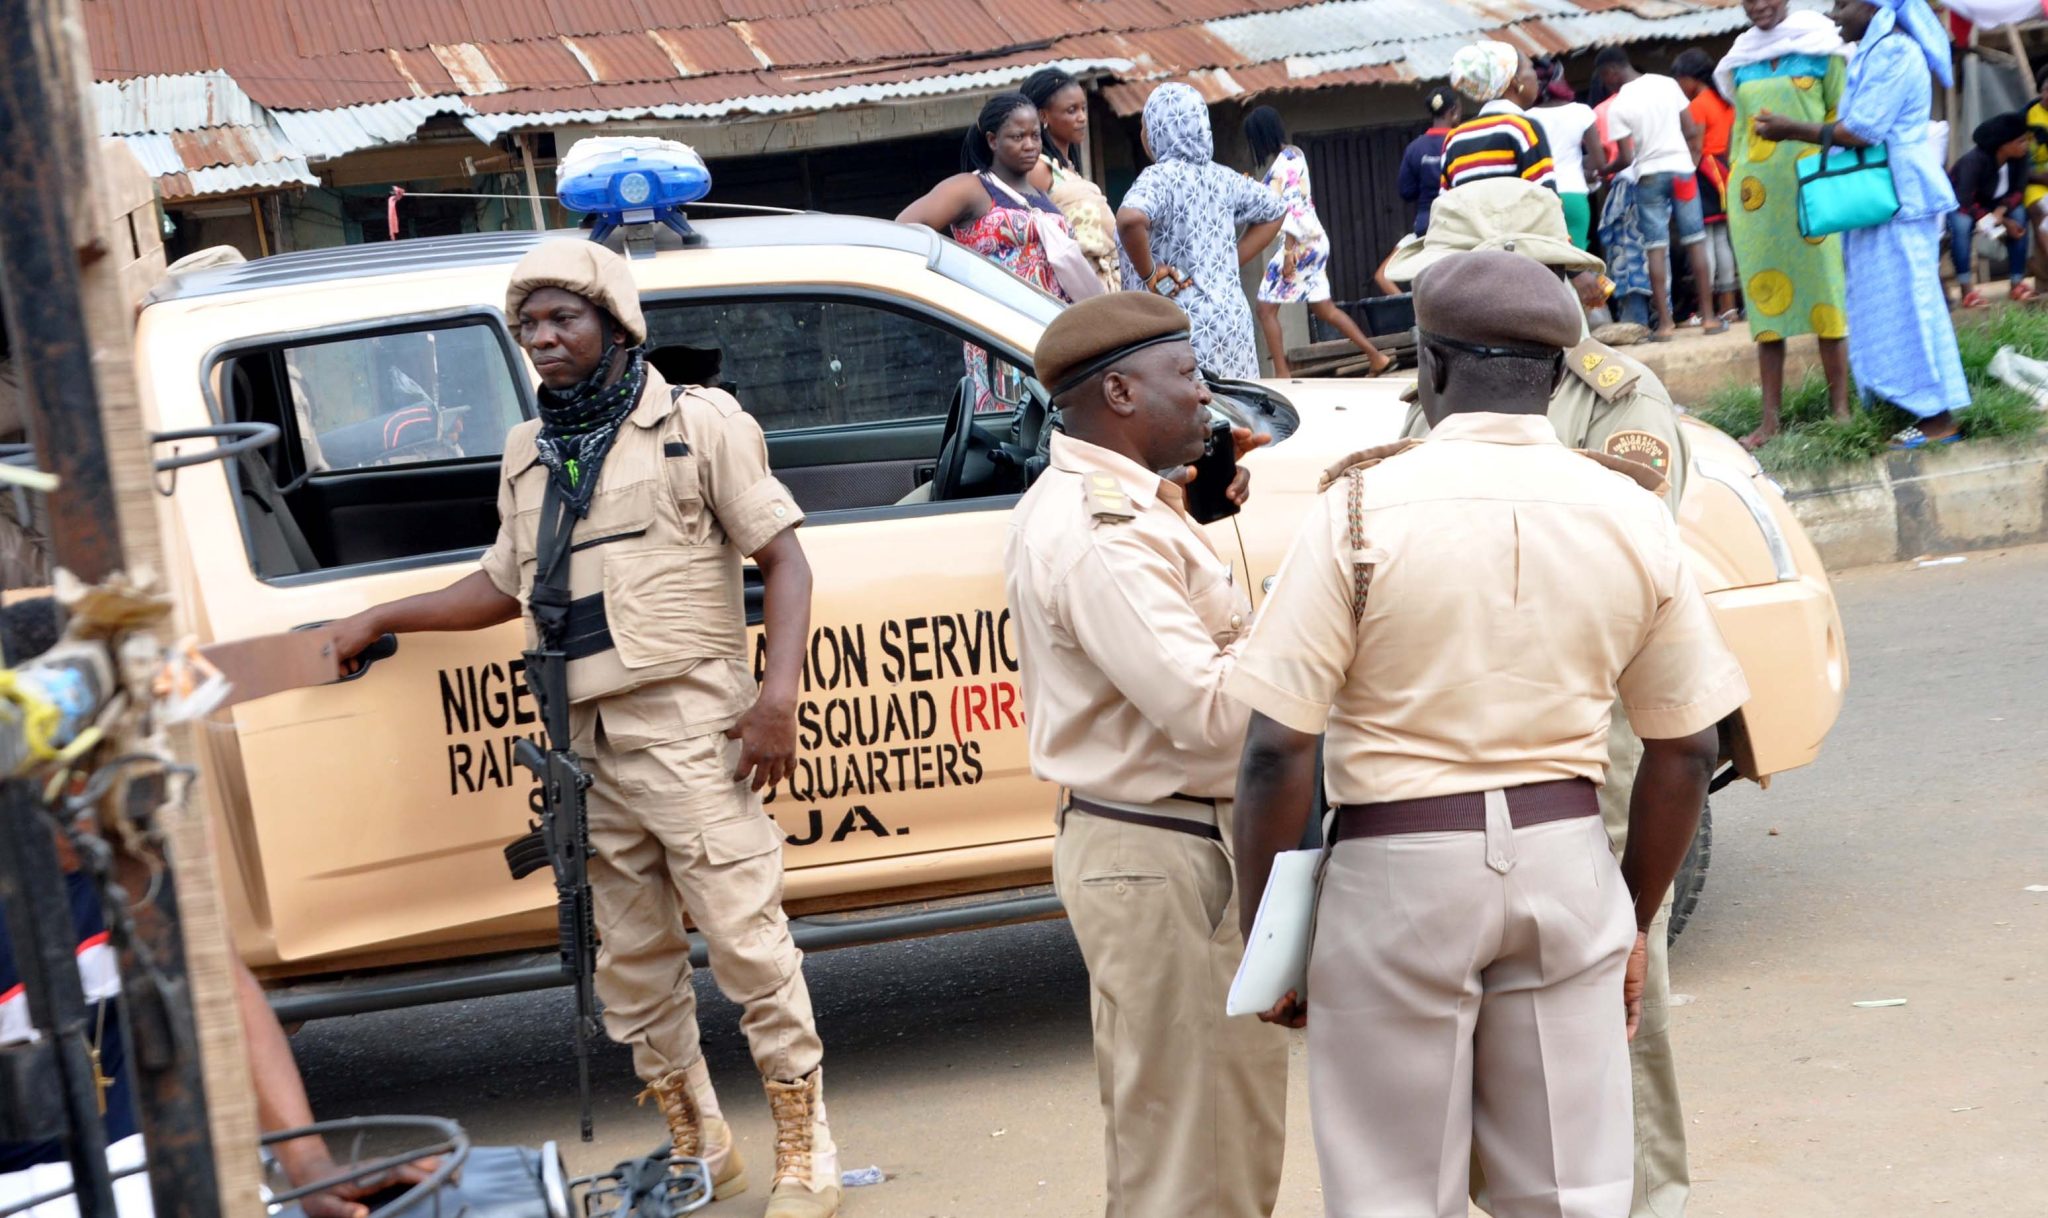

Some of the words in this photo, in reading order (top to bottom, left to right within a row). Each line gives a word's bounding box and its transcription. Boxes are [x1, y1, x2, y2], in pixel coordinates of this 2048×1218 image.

[438, 659, 536, 735] NIGE
[880, 608, 1019, 685] SERVIC
[797, 690, 937, 750] SQUAD
[950, 682, 1026, 747] (RR
[763, 741, 983, 804] QUARTERS
[769, 805, 910, 846] JA.
